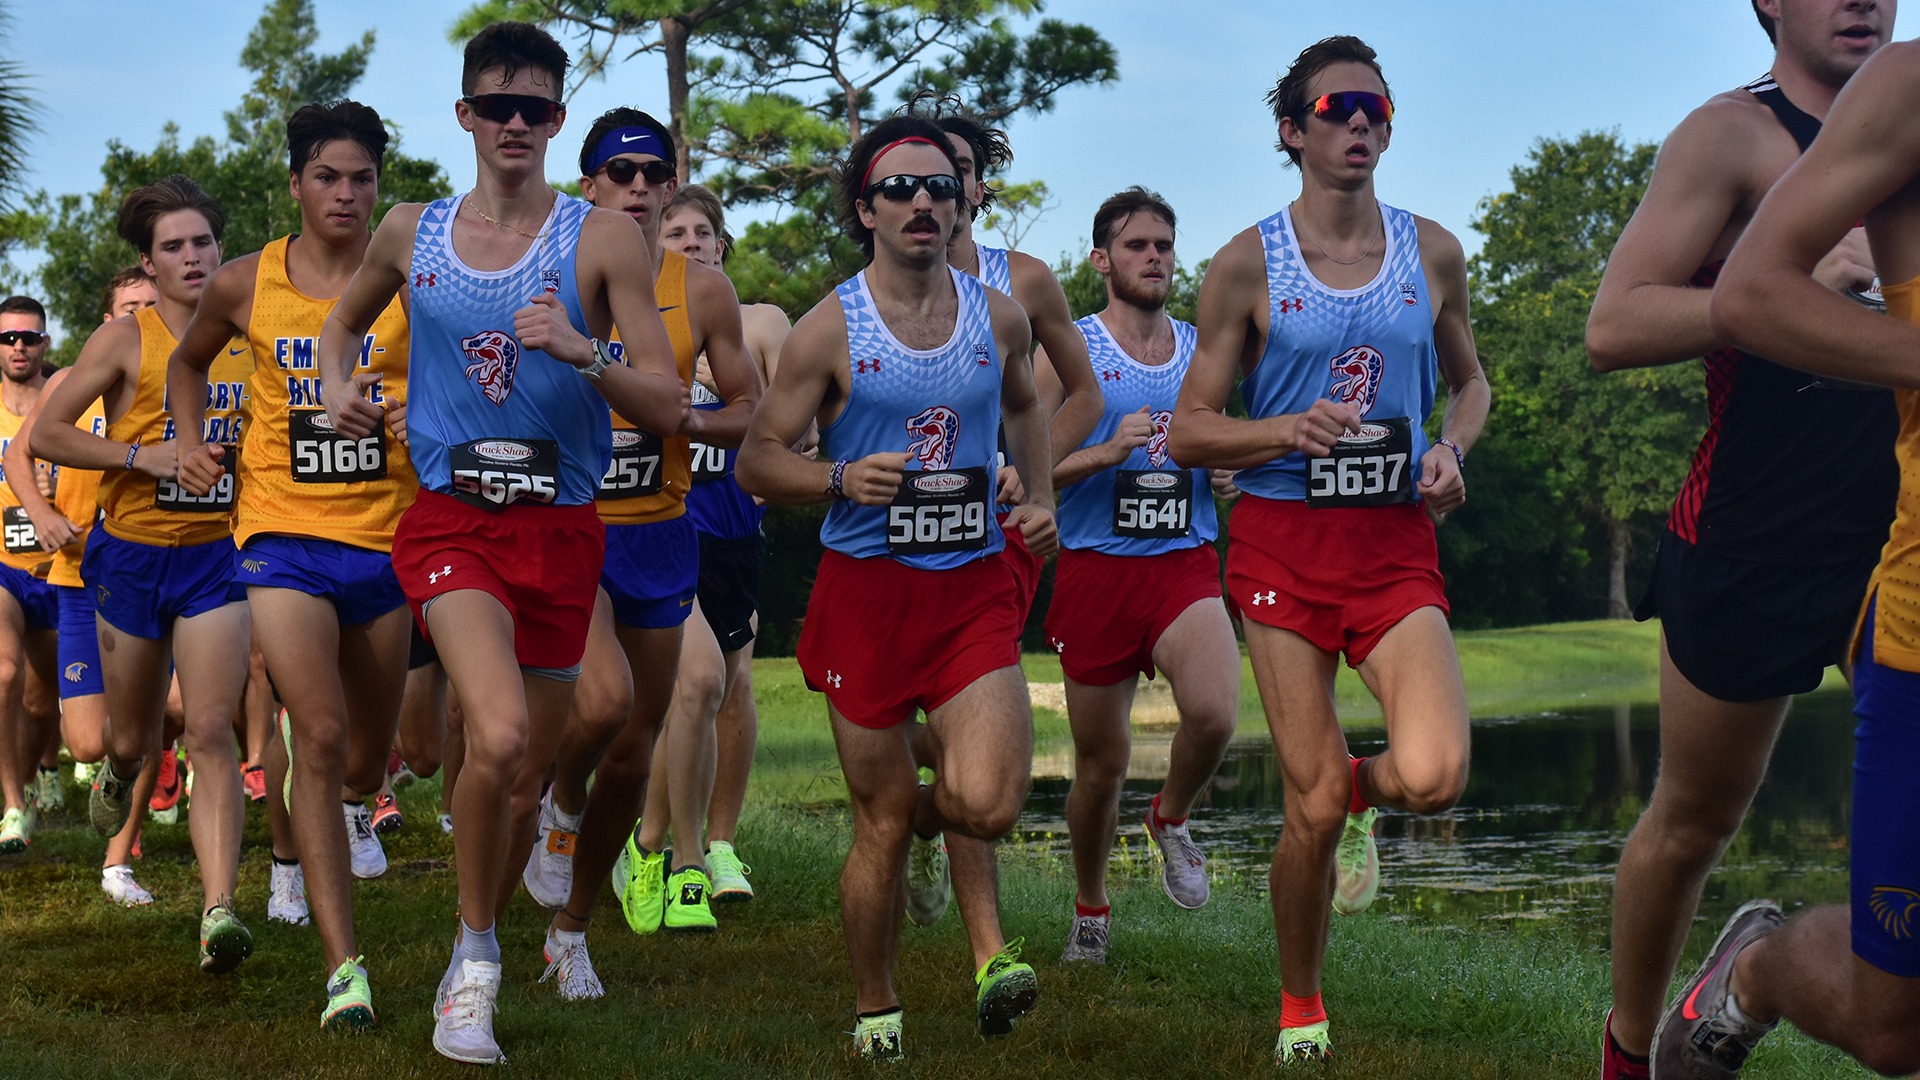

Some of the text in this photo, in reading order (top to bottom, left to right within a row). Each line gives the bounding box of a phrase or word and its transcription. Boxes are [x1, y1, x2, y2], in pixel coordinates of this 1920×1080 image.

[275, 336, 386, 370] EMY-
[1361, 426, 1390, 438] Shack
[296, 437, 380, 473] 5166
[475, 444, 502, 455] Track
[502, 446, 534, 457] Shack
[454, 469, 557, 505] 5625
[915, 476, 970, 488] Track Shack
[1311, 453, 1407, 497] 5637
[889, 501, 985, 544] 5629
[1118, 498, 1187, 530] 5641
[5, 524, 38, 547] 52
